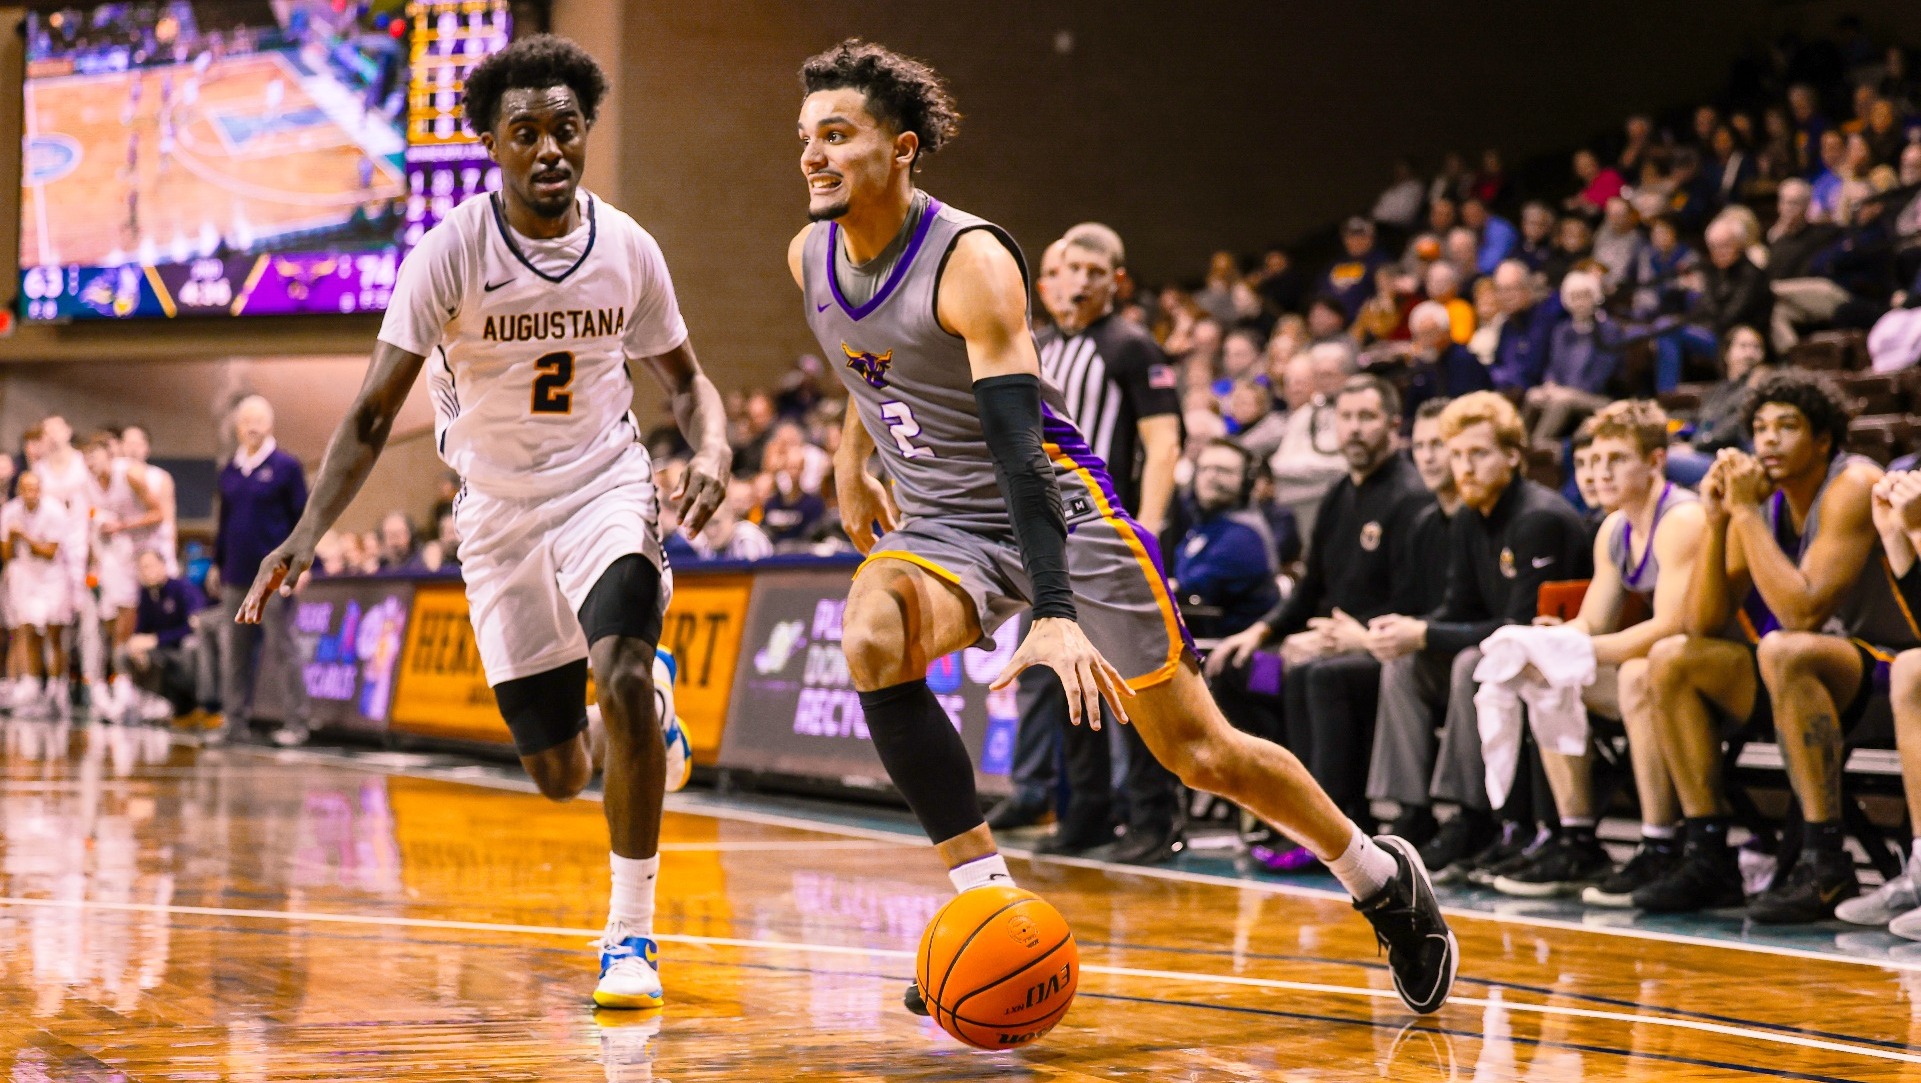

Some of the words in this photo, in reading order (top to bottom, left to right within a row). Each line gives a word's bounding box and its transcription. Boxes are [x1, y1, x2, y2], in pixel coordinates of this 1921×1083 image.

[482, 306, 625, 342] AUGUSTANA
[529, 350, 576, 415] 2
[879, 400, 936, 459] 2
